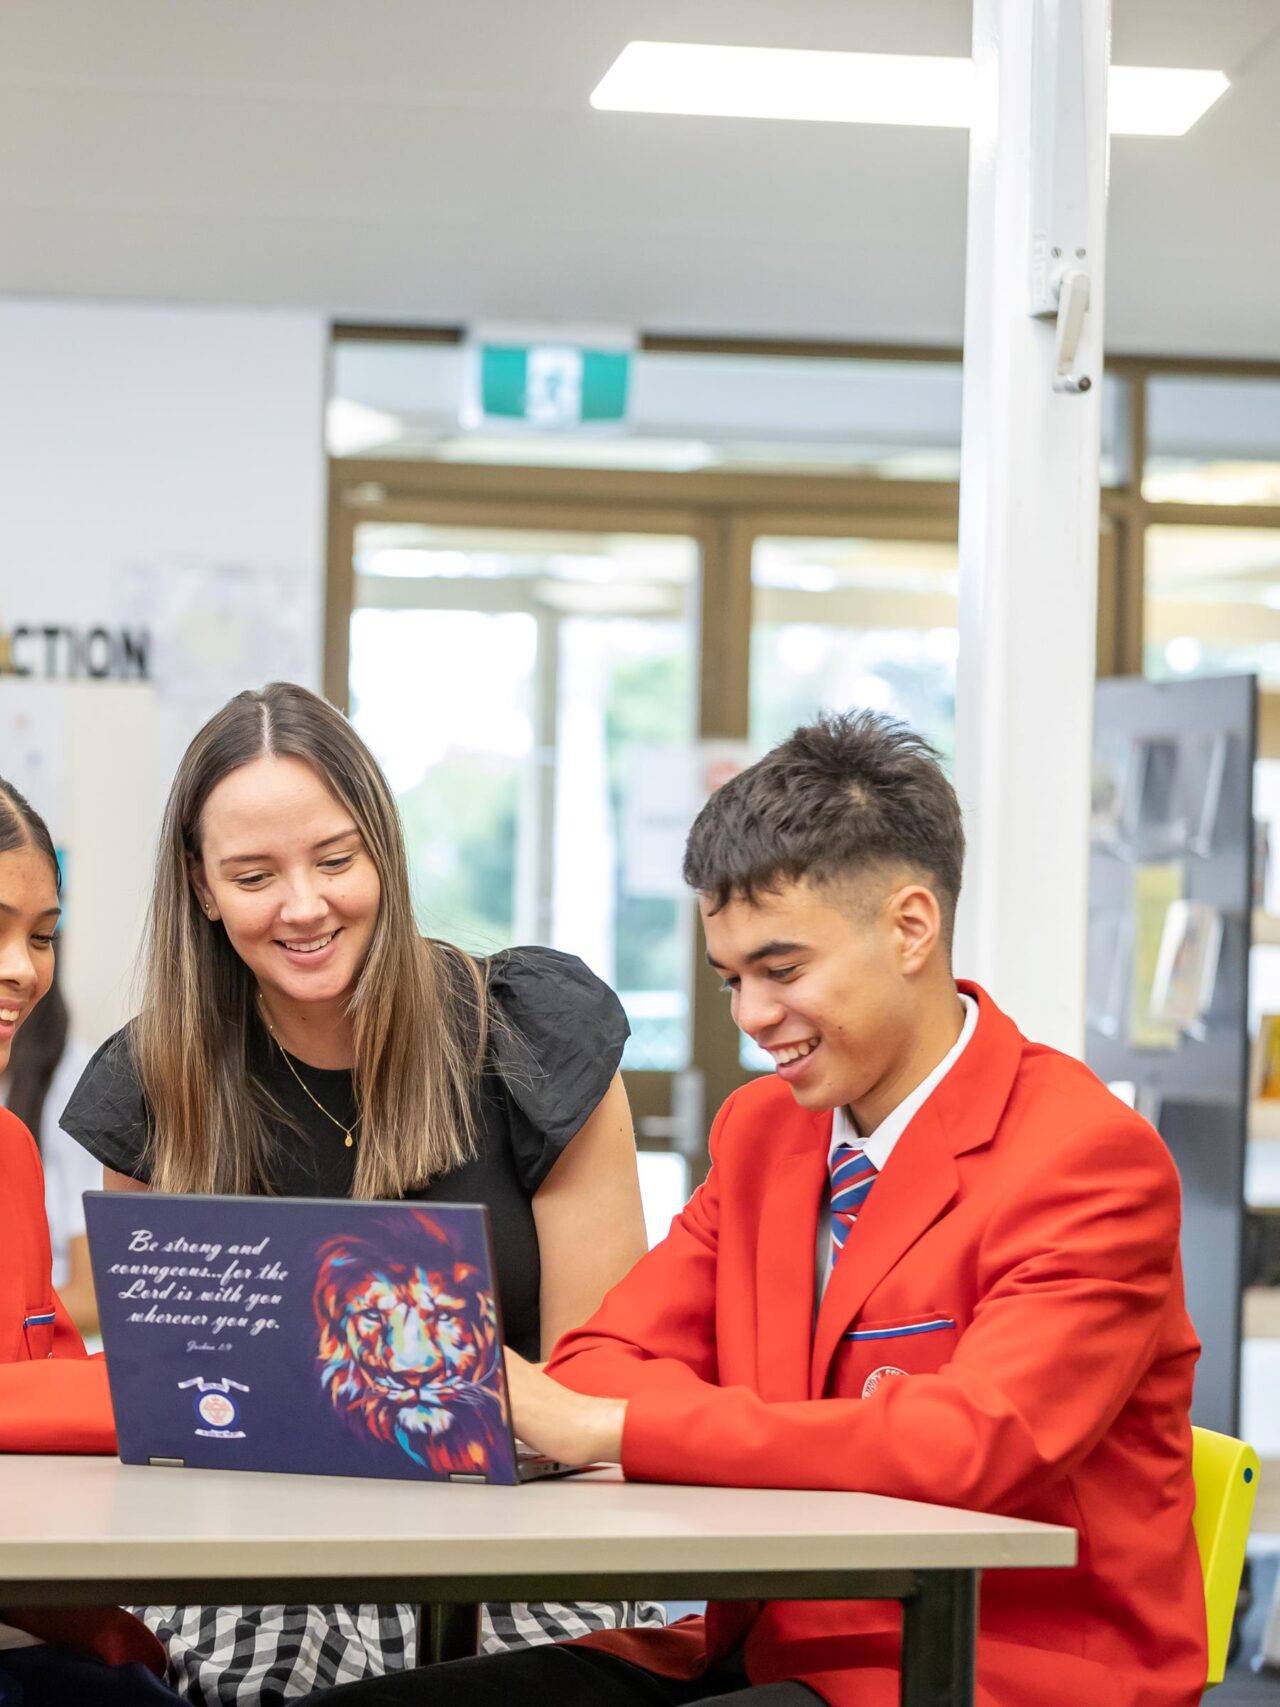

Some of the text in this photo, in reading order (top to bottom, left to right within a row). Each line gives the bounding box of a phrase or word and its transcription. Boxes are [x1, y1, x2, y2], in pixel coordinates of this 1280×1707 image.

[7, 623, 152, 680] CTION
[128, 1229, 270, 1262] Be strong and
[254, 1260, 289, 1281] the
[117, 1278, 282, 1313] Lord is with you
[126, 1304, 280, 1336] wherever you go.
